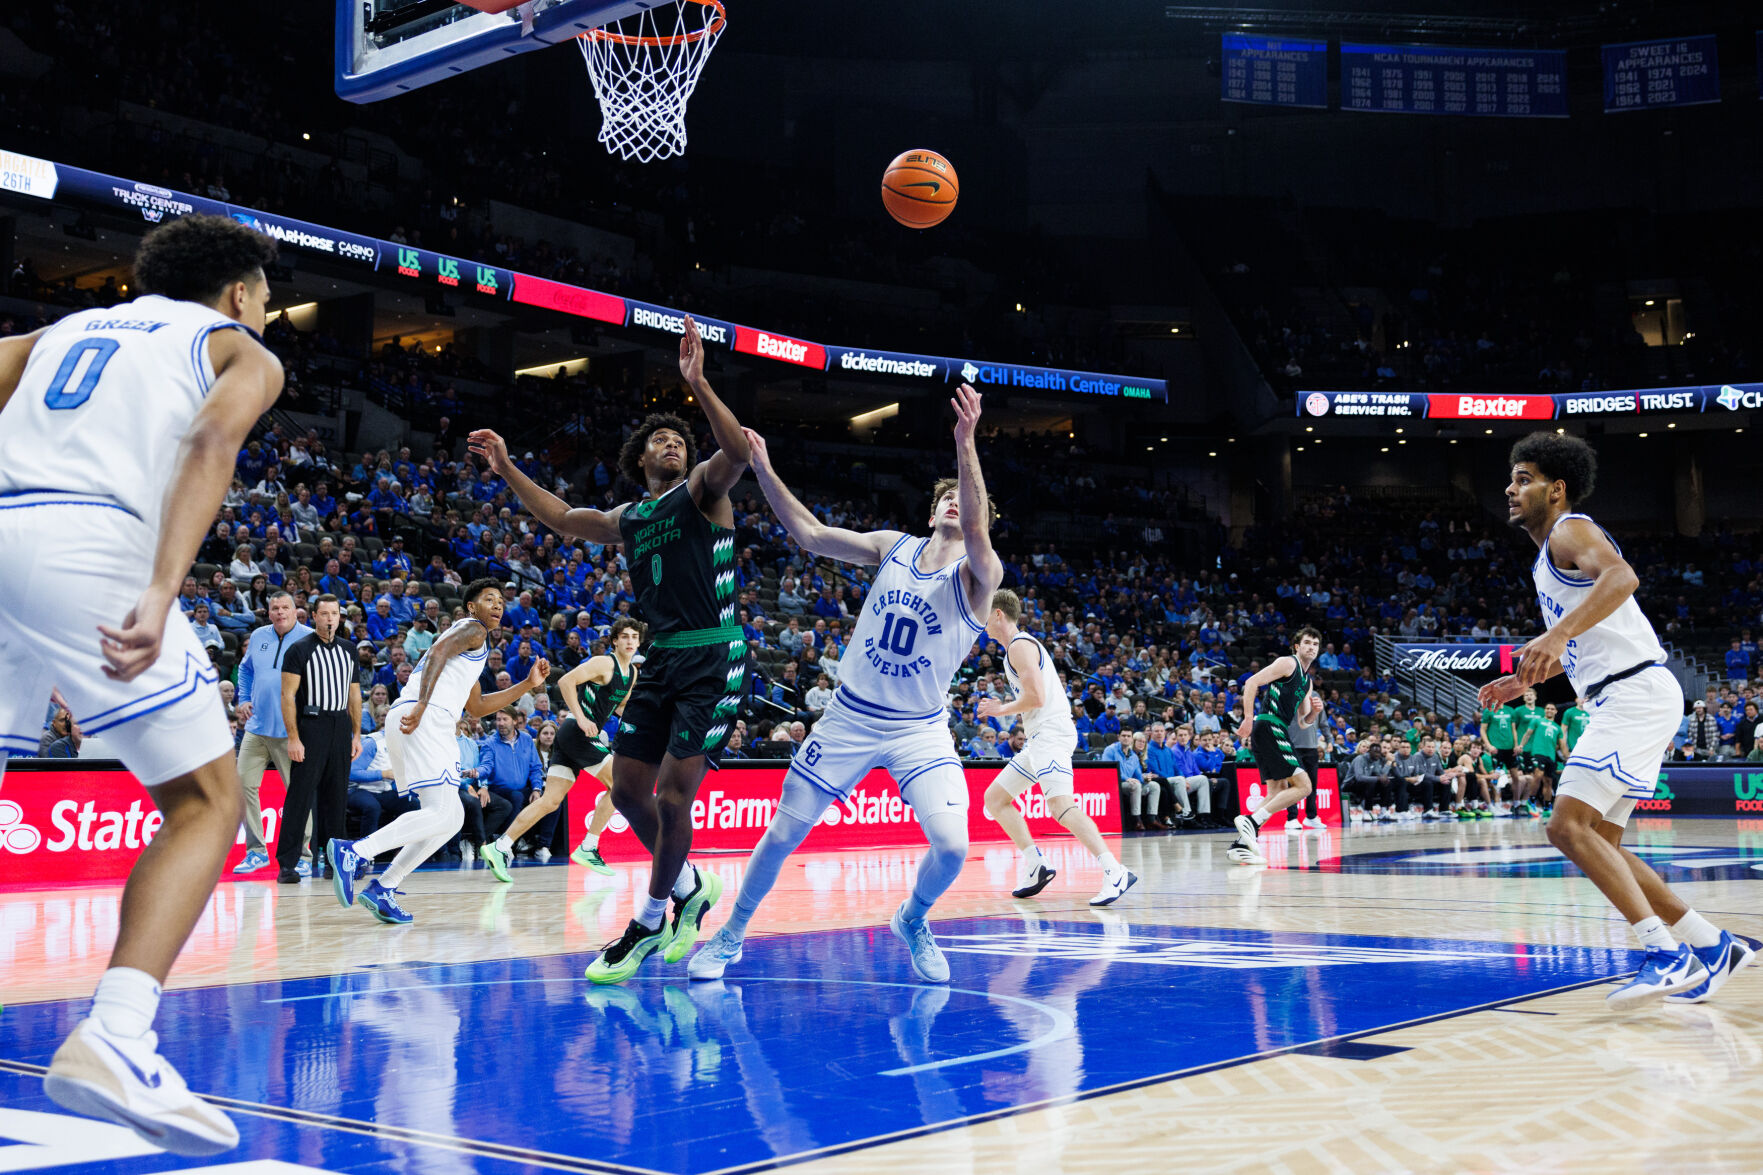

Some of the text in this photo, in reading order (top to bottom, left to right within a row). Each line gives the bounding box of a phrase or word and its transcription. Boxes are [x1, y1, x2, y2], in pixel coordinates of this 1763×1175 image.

[1240, 48, 1309, 62] APPEARANCES
[1629, 42, 1688, 58] SWEET 16
[1374, 53, 1535, 68] NCAA TOURNAMENT APPEARANCES
[1617, 52, 1703, 71] APPEARANCES
[1352, 67, 1370, 77] 1941
[1536, 73, 1559, 83] 2024
[1615, 65, 1708, 82] 1941 1974 2024
[1228, 79, 1246, 88] 1977
[1615, 80, 1674, 94] 1962 2021
[1352, 98, 1371, 108] 1974
[1476, 103, 1497, 113] 2017
[1506, 104, 1530, 114] 2023
[1616, 91, 1677, 106] 1964 2023
[905, 154, 946, 173] ELITE
[3, 171, 31, 191] 26TH
[112, 186, 150, 203] TRUCK
[150, 195, 193, 213] CENTER
[338, 241, 374, 257] CASINO
[398, 265, 419, 278] FOODS
[438, 274, 459, 287] FOODS
[477, 283, 497, 295] FOODS
[84, 320, 171, 333] GREEN
[634, 308, 726, 343] BRIDGES RUST.
[757, 334, 807, 362] Baxter
[841, 352, 936, 377] ticketmaster
[43, 337, 121, 411] 0
[979, 366, 1151, 399] CHI Health Center OMAHA
[1334, 394, 1410, 404] ABE'S TRASH
[1458, 396, 1527, 416] Baxter
[1566, 396, 1636, 413] BRIDGES
[1334, 406, 1412, 416] SERVICE INC.
[634, 515, 675, 543] NORTH
[634, 528, 681, 560] DAKOTA
[651, 553, 662, 585] 0
[872, 589, 942, 635] CREIGHTON
[878, 612, 919, 656] 10
[865, 637, 932, 678] BLUEJAYS
[1400, 649, 1495, 671] Michelob
[843, 788, 903, 825] State
[1635, 800, 1672, 810] FOODS
